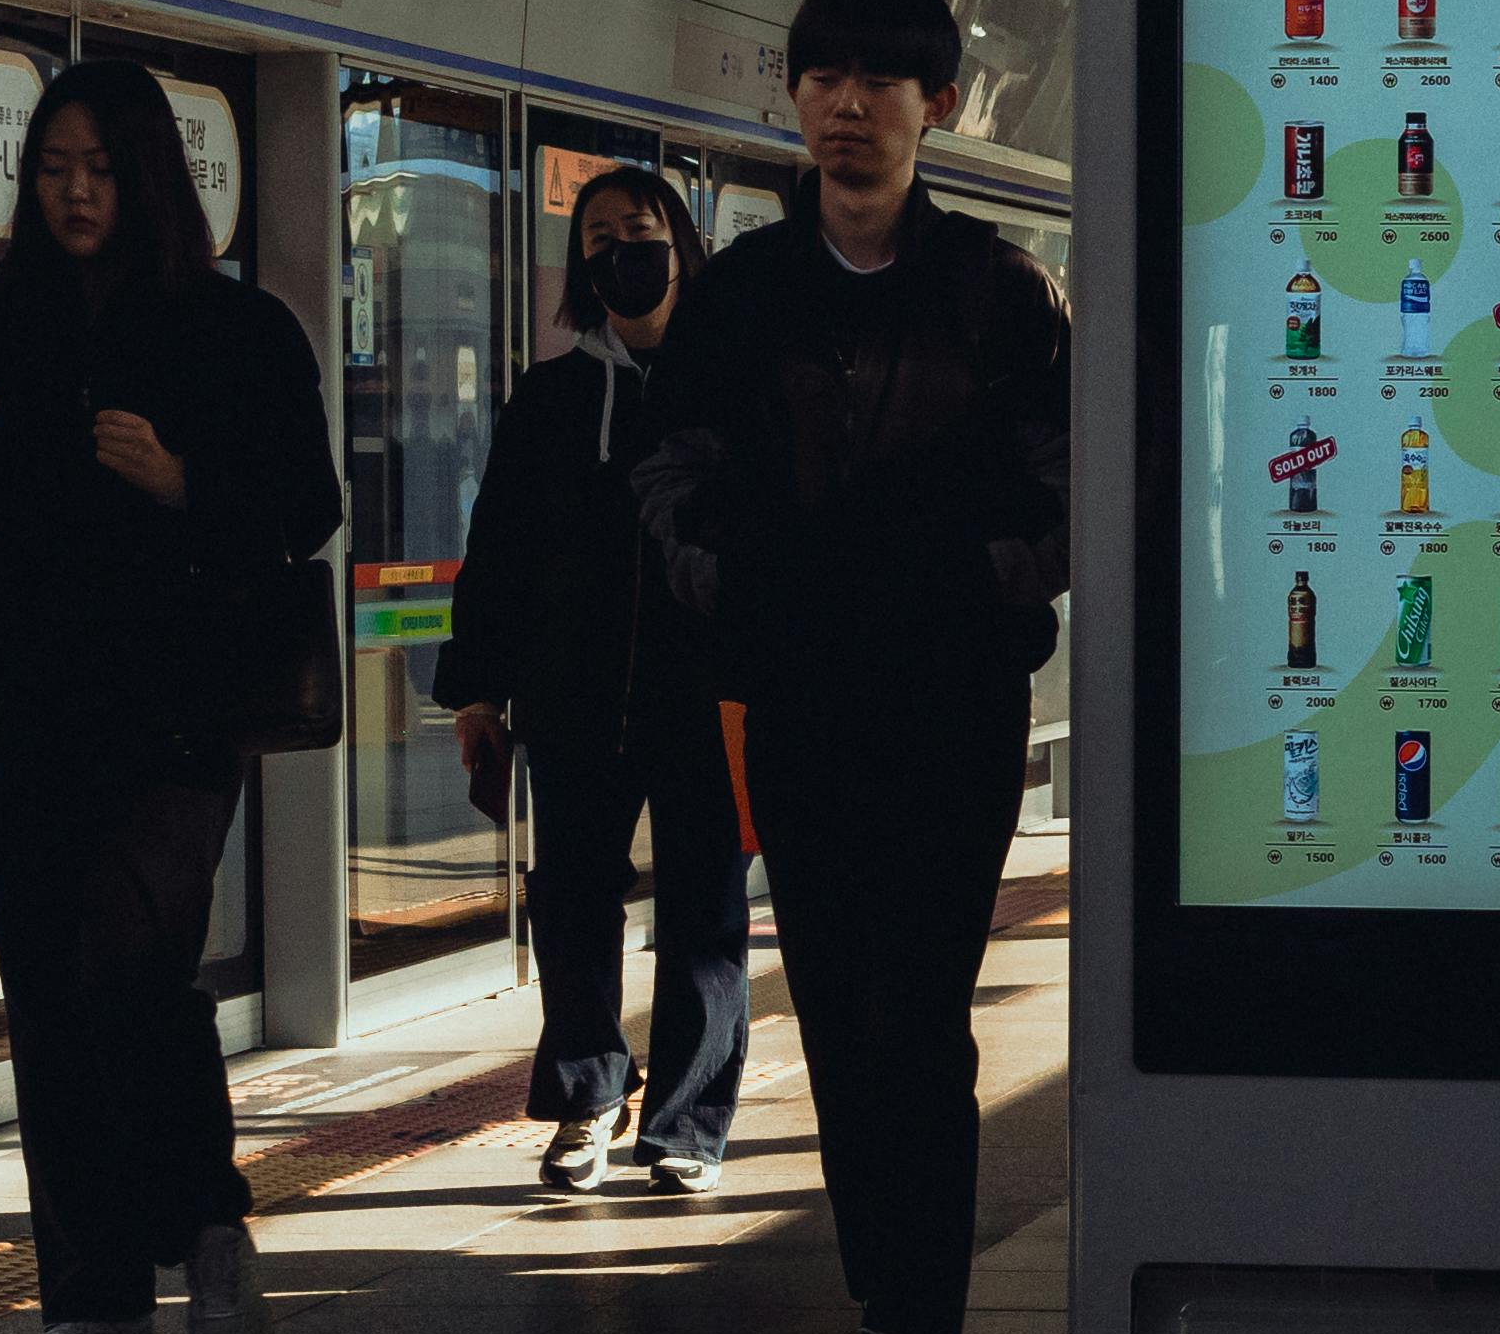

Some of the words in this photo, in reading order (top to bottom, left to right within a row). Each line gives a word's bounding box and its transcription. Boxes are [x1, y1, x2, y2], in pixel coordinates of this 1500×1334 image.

[1309, 75, 1338, 86] 1400
[1420, 75, 1451, 86] 2600
[186, 117, 205, 151] 대상
[211, 161, 227, 193] 1위
[1315, 231, 1337, 242] 700
[1420, 231, 1450, 242] 2600
[1308, 387, 1337, 397] 1800
[1419, 387, 1449, 397] 2300
[1274, 453, 1305, 476] SOLD
[1307, 443, 1331, 462] OUT
[1283, 521, 1320, 531] 하늘보리
[1307, 542, 1336, 552] 1800
[1419, 542, 1448, 553] 1800
[1389, 677, 1437, 687] 칠성사이다
[1306, 697, 1335, 707] 2000
[1418, 698, 1447, 709] 1700
[1287, 832, 1315, 842] 밀키스
[1305, 852, 1334, 863] 1500
[1417, 854, 1446, 864] 1600
